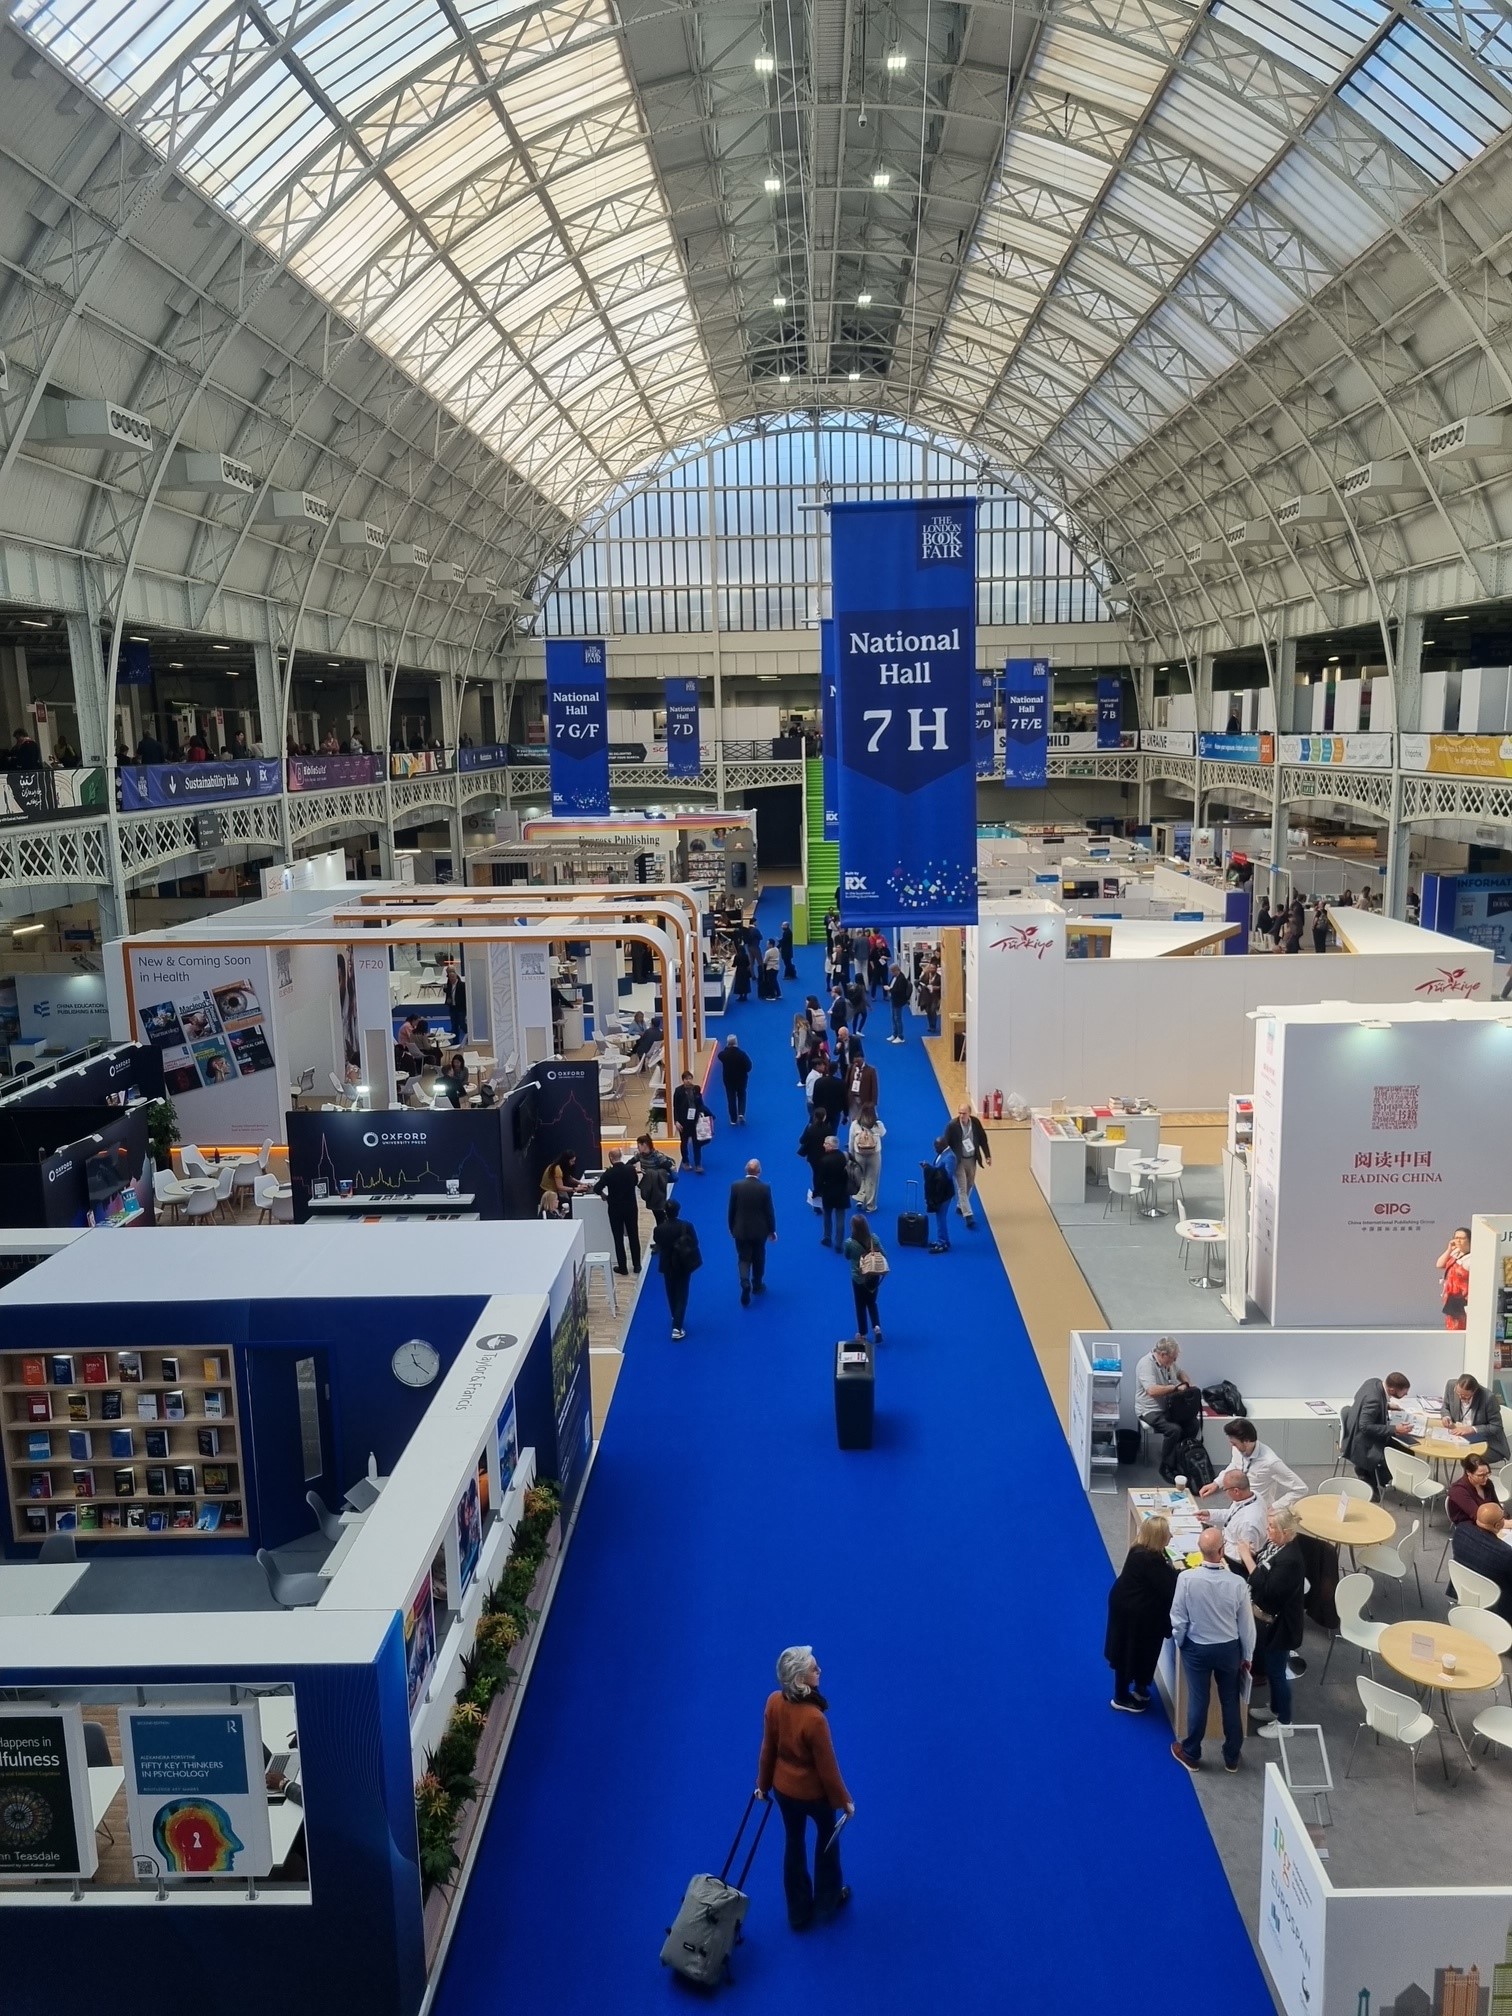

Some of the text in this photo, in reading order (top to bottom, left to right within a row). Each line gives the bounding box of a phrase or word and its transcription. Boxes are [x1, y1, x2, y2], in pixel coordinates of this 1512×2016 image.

[931, 516, 952, 525] THE
[922, 523, 962, 533] LONDON
[922, 531, 963, 546] BOOK
[922, 545, 963, 559] FAIR
[849, 628, 961, 655] National
[879, 662, 931, 686] Hall
[553, 692, 600, 702] National
[1010, 696, 1044, 704] National
[565, 706, 588, 715] Hall
[1018, 705, 1035, 713] Hall
[1102, 711, 1108, 719] 7
[673, 724, 694, 736] 7 D
[862, 707, 949, 753] 7 H
[1011, 718, 1042, 730] 7 F/E
[555, 724, 600, 739] 7 G/F
[185, 773, 240, 790] Sustainability Hub
[614, 835, 660, 847] Publishing
[845, 876, 867, 890] RX
[989, 937, 1053, 960] Türkiye
[138, 955, 251, 969] New & Coming Soon
[360, 960, 384, 969] 7F20
[140, 972, 190, 983] in Health
[1415, 979, 1481, 999] Türkiye
[1354, 1151, 1432, 1168] 阅读中国
[1342, 1172, 1442, 1184] READING CHINA
[1374, 1203, 1411, 1215] CIPG
[475, 1353, 498, 1374] Taylor
[455, 1383, 482, 1411] Francis
[226, 1720, 237, 1733] R
[43, 1736, 51, 1747] in
[182, 1761, 224, 1769] THINKERS
[153, 1770, 209, 1778] PSYCHOLOGY
[14, 1851, 60, 1861] Teasdale
[1270, 1870, 1311, 1969] EUROSPAN
